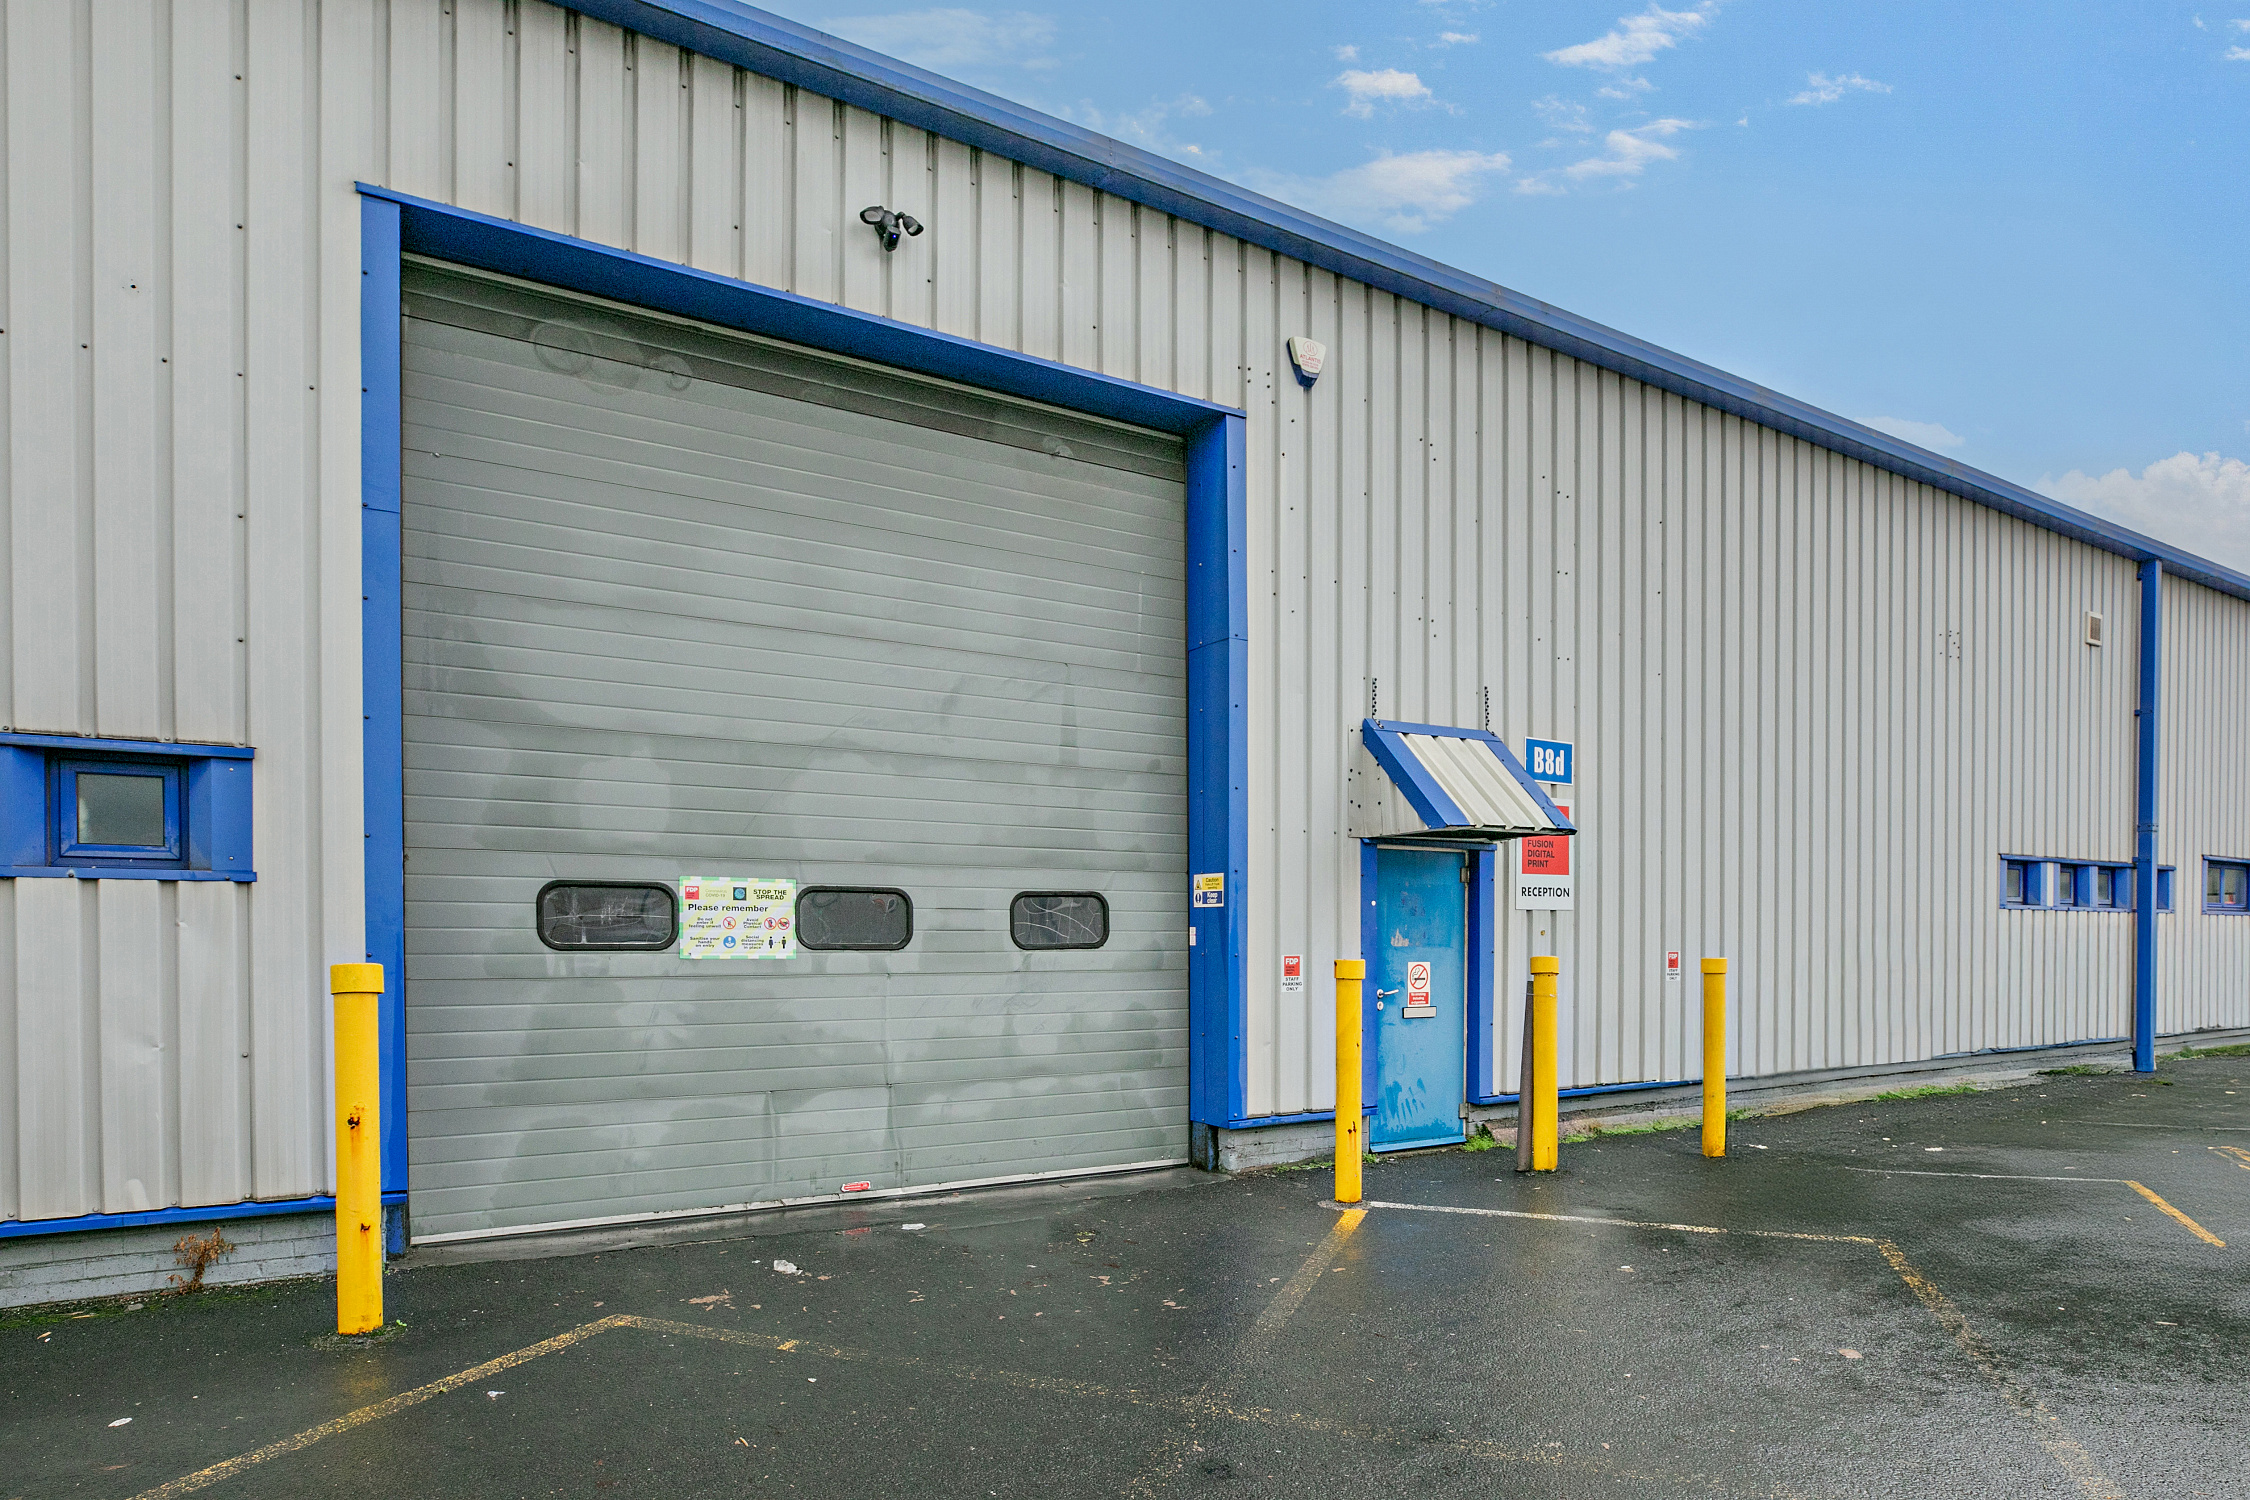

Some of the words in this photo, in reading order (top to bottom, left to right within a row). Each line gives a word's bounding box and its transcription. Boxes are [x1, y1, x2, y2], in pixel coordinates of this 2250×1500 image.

[1300, 353, 1321, 364] ATLANTIS
[1533, 746, 1565, 776] B8d
[1527, 839, 1554, 848] FUSION
[1527, 849, 1555, 858] DIGITAL
[1527, 859, 1549, 868] PRINT
[1521, 886, 1570, 897] RECEPTION
